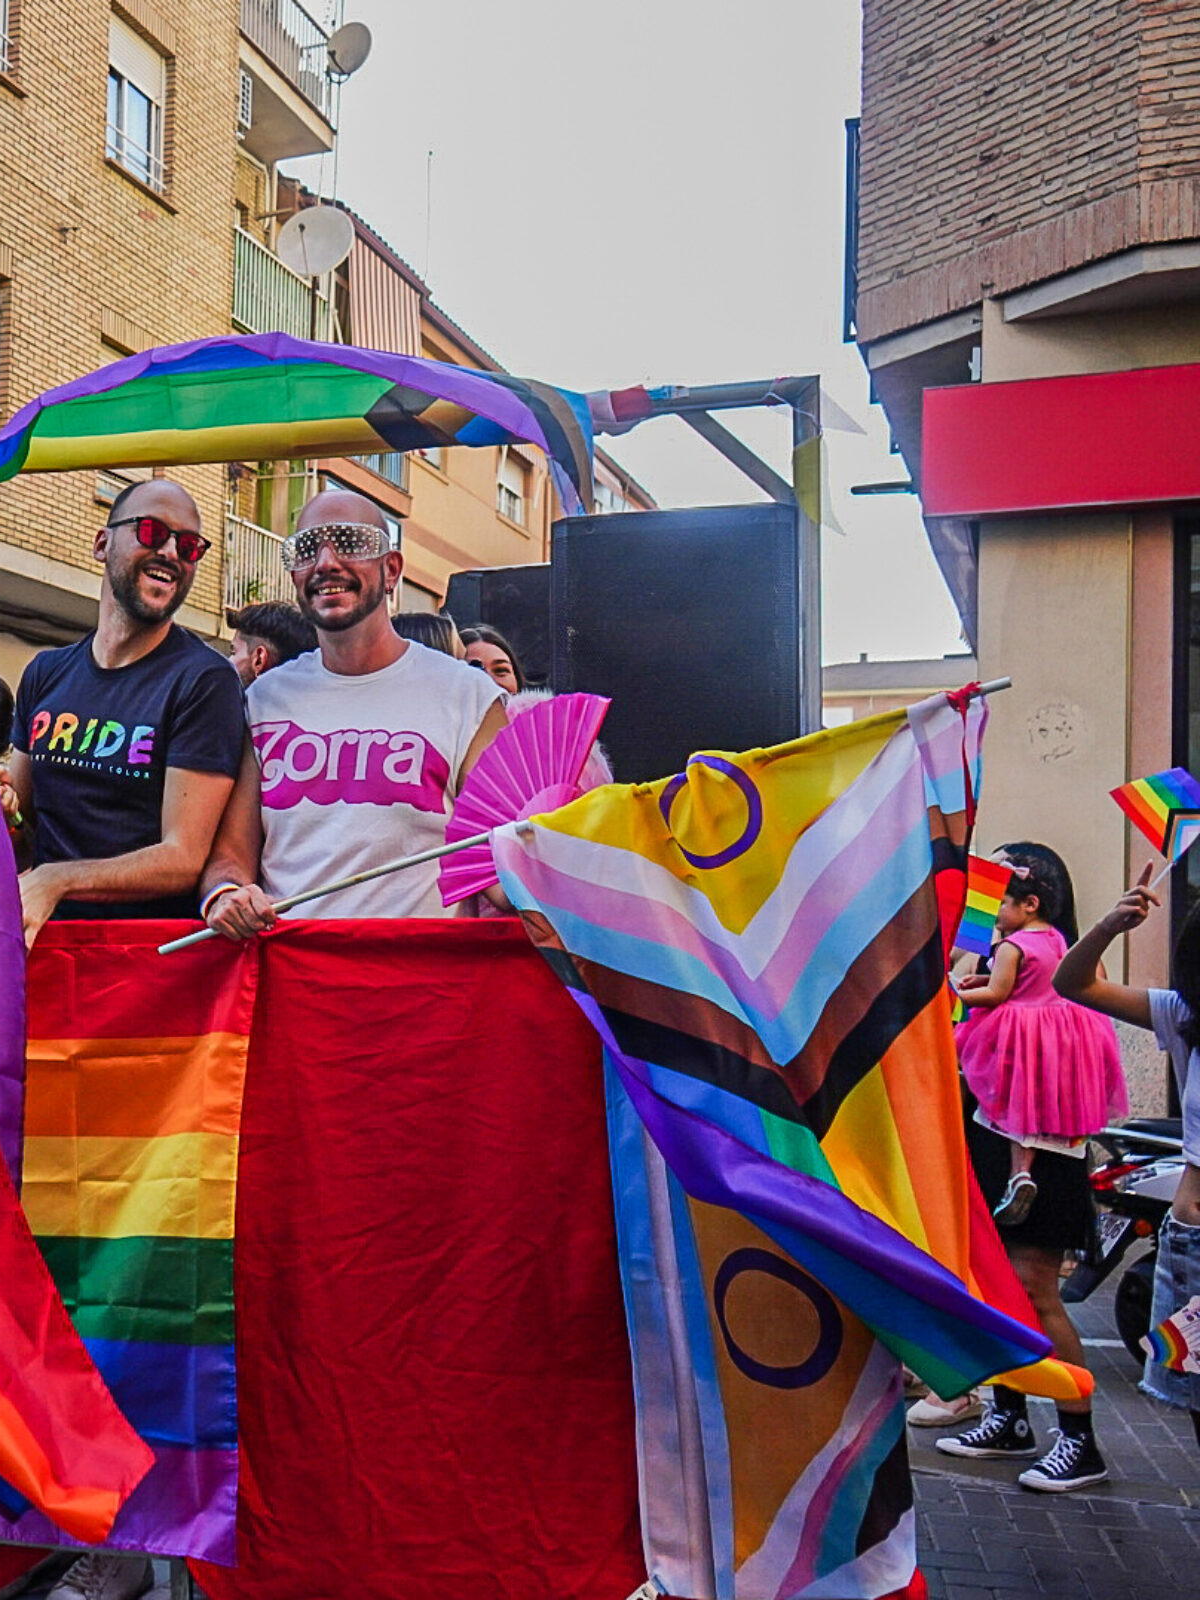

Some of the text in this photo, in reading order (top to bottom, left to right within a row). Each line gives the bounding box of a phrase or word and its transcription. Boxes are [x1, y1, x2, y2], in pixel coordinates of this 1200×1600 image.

[29, 711, 155, 764] PRIDE
[252, 722, 426, 792] Zorra
[109, 766, 150, 779] COLOR
